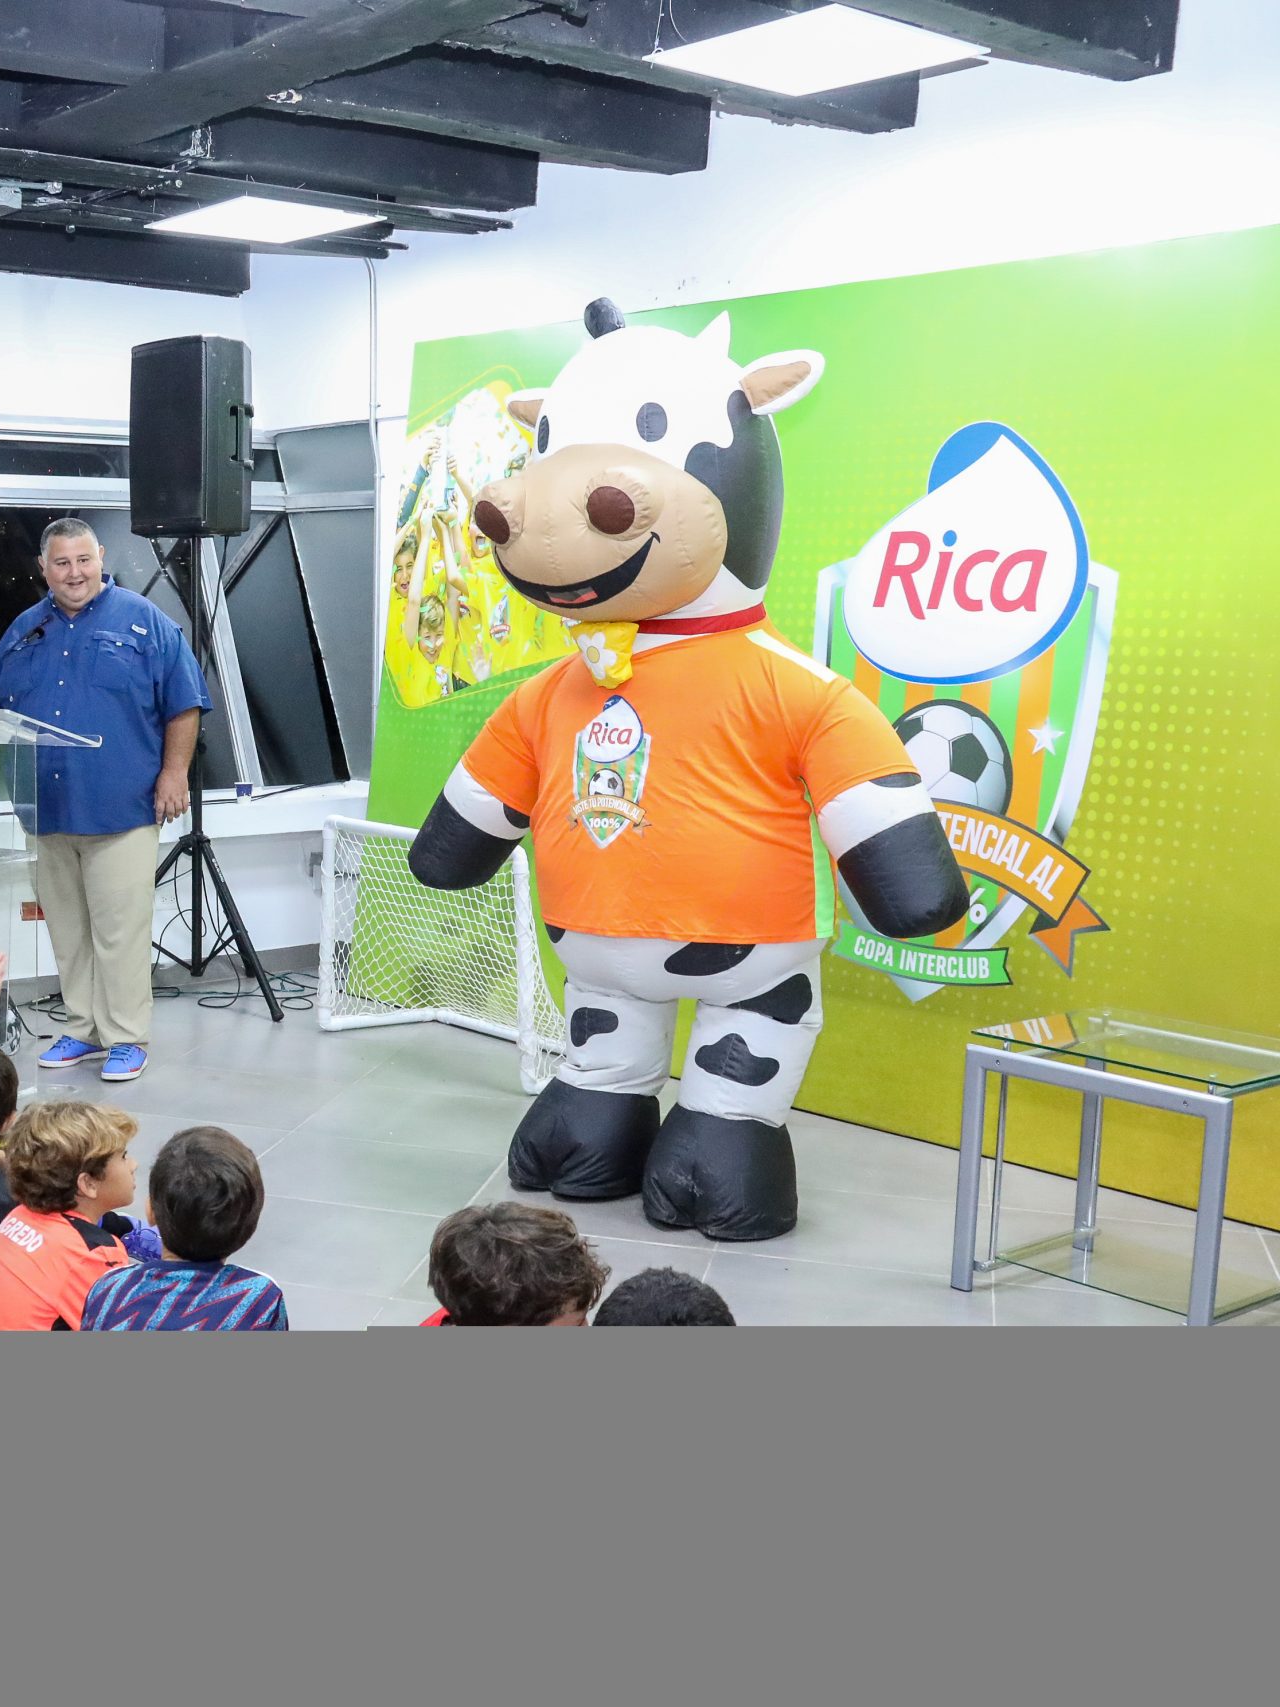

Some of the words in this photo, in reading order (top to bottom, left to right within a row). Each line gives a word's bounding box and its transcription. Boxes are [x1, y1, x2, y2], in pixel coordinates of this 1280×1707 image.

[872, 529, 1048, 620] Rica
[587, 721, 633, 747] Rica
[588, 817, 620, 829] 100%
[937, 811, 1031, 880] TENCIAL
[1025, 854, 1065, 902] AL
[853, 935, 894, 967] COPA
[899, 948, 990, 979] INTERCLUB
